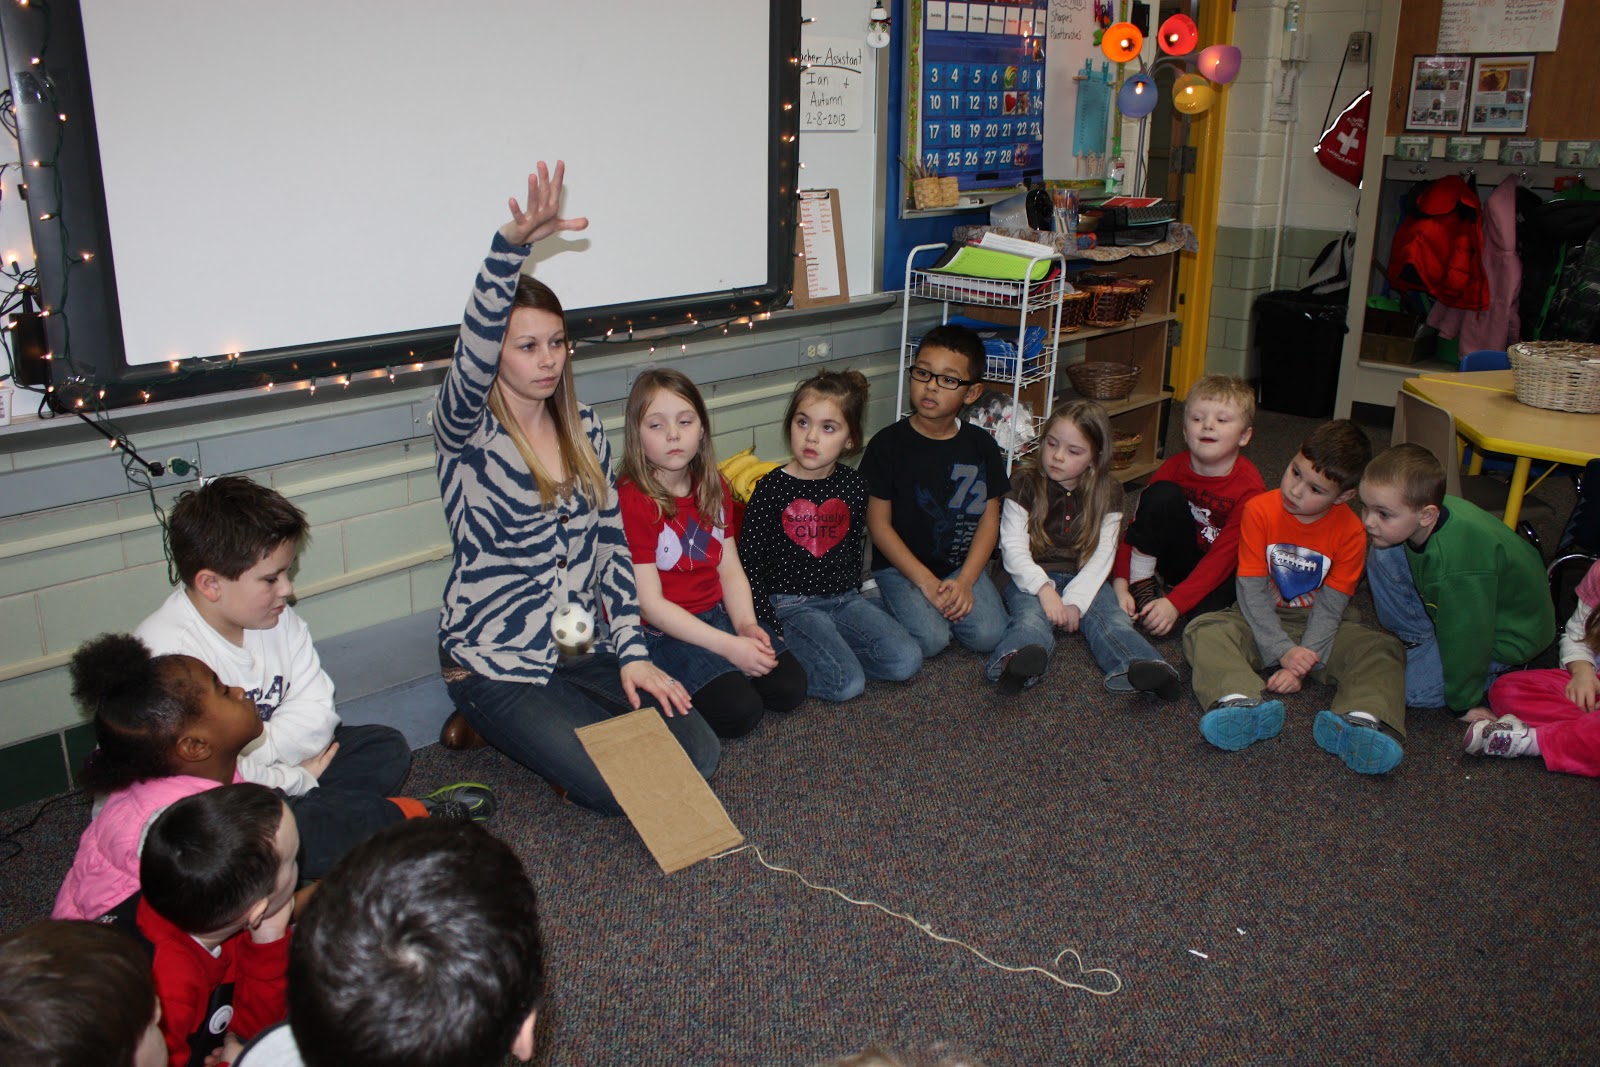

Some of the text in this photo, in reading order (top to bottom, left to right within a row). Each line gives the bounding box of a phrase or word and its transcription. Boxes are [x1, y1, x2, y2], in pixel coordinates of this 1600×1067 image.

[800, 47, 863, 66] acher Assistant
[806, 72, 829, 86] Ian
[931, 67, 939, 83] 3
[950, 68, 959, 83] 4
[973, 69, 981, 84] 5
[991, 70, 998, 84] 6
[1021, 69, 1028, 84] 8
[809, 91, 843, 107] Autumn
[929, 94, 1041, 110] 10 11 12 13 16
[805, 111, 846, 127] 2-8-2013
[929, 122, 1040, 139] 17 18 19 20 21 22 23
[926, 149, 1012, 168] 24 25 26 27 28
[948, 463, 988, 515] 72
[787, 511, 846, 525] seriously
[795, 525, 838, 539] CUTE
